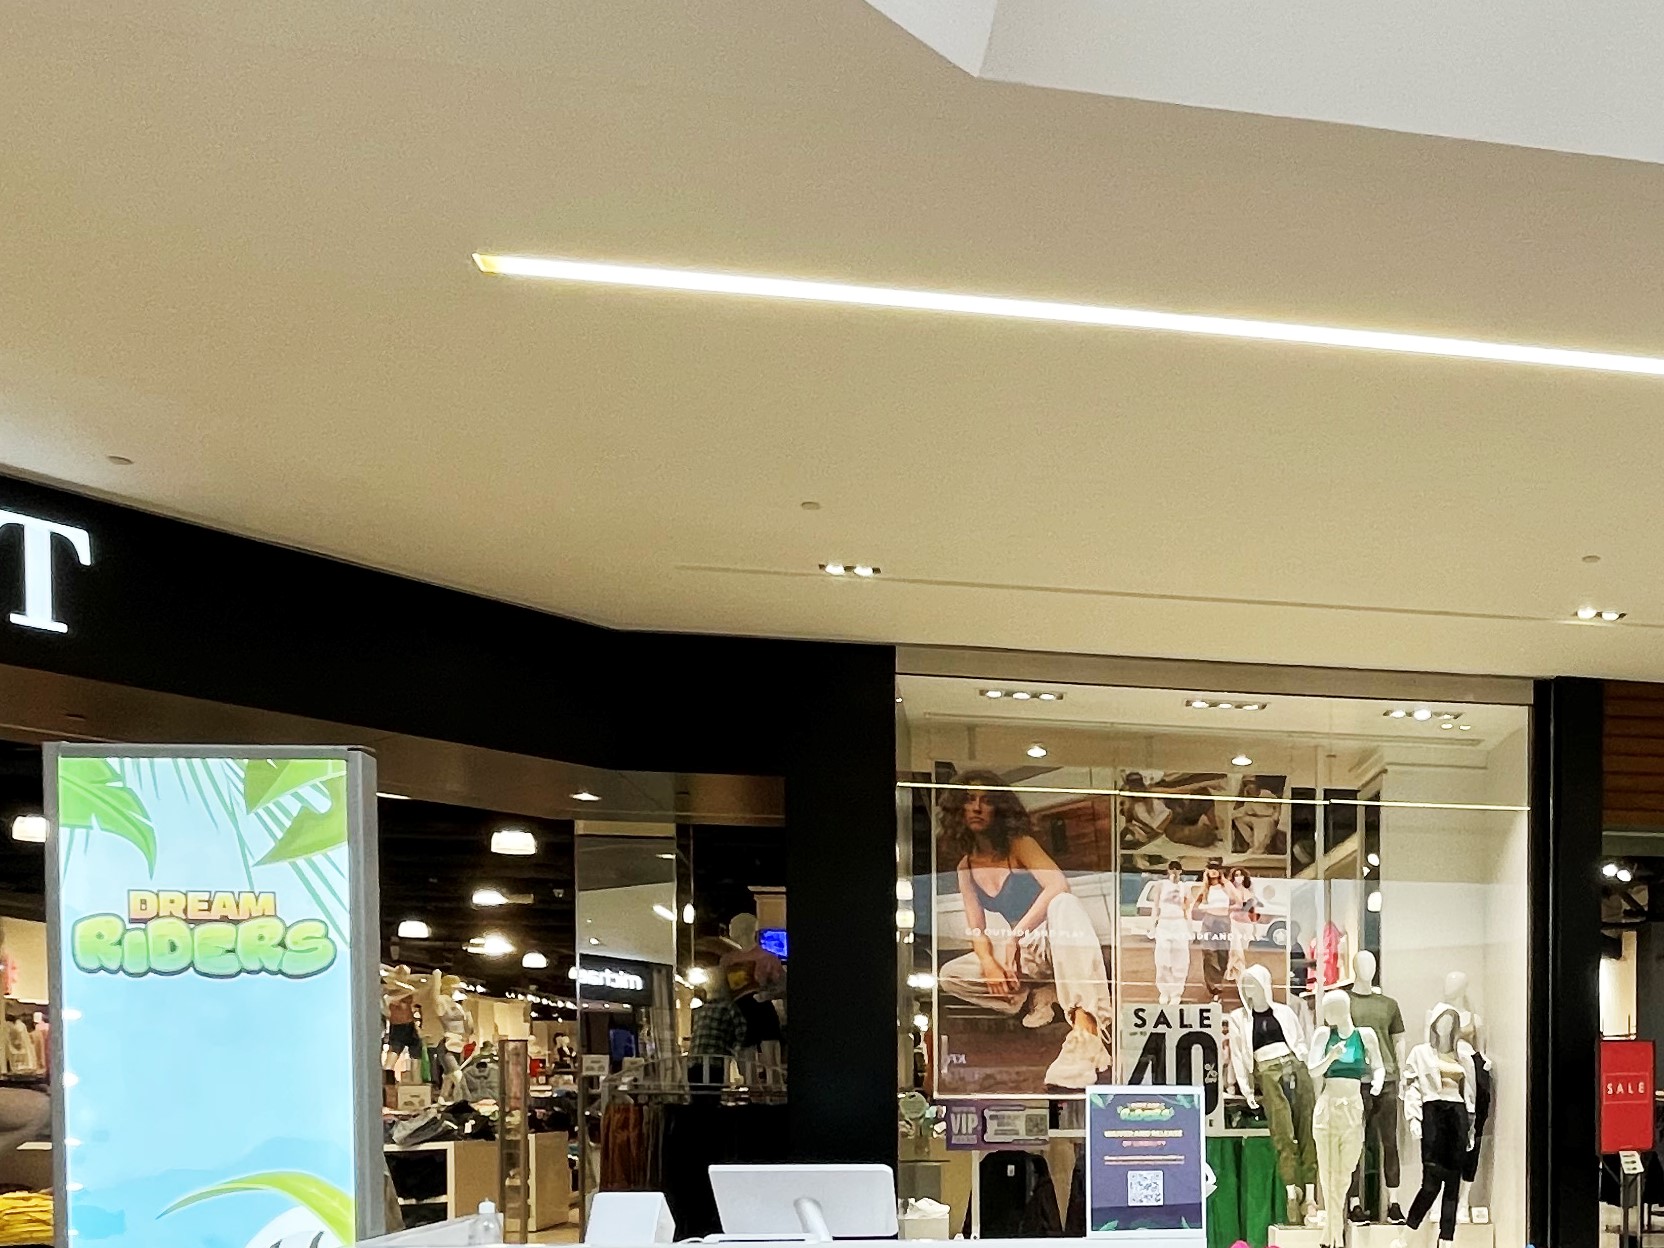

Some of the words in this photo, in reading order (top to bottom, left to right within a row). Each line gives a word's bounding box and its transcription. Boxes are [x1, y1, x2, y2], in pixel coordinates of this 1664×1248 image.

[127, 889, 277, 923] DREAM
[1133, 1008, 1212, 1029] SALE
[1606, 1081, 1645, 1095] SALE
[950, 1113, 979, 1134] VIP
